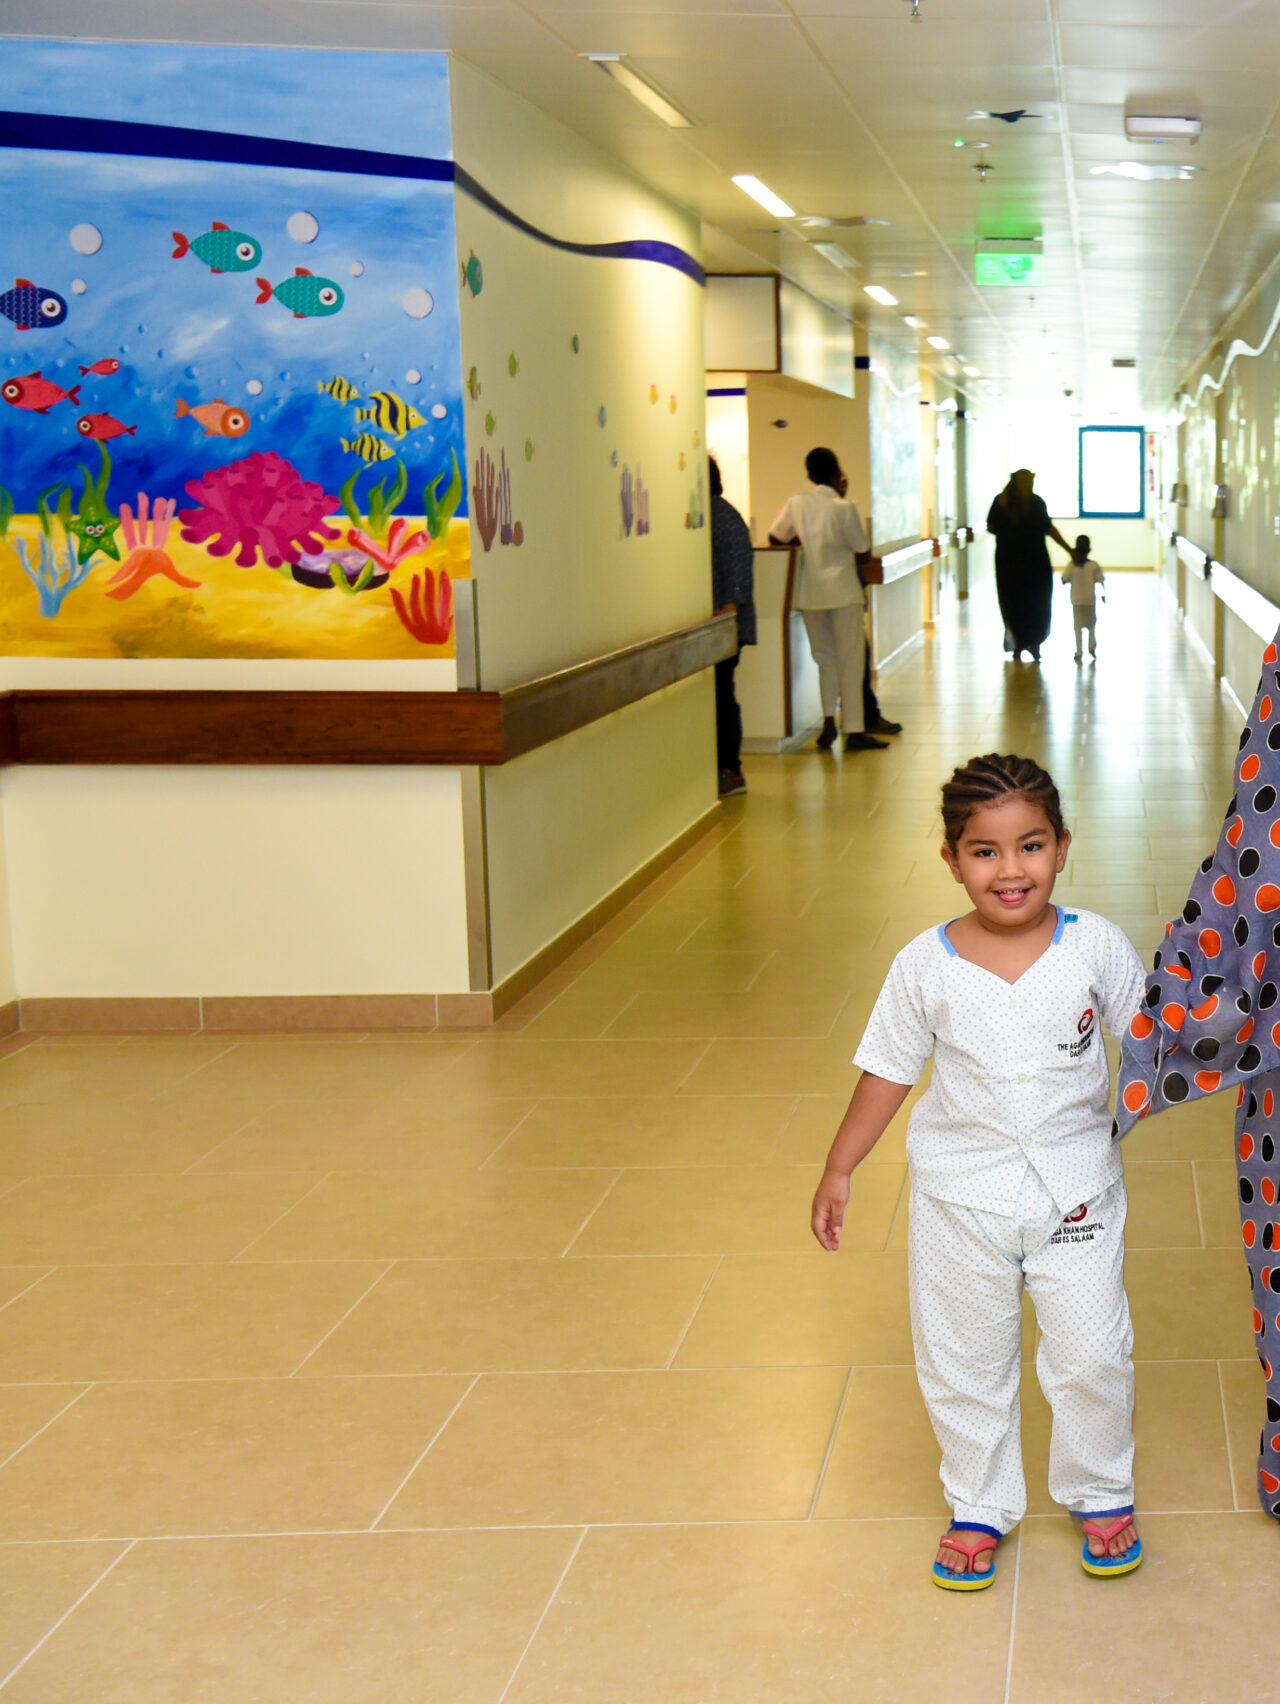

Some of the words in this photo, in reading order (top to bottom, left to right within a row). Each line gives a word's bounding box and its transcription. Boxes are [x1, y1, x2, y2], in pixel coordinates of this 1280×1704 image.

[1063, 1226, 1079, 1234] KHAN
[1080, 1222, 1105, 1232] HOSPITAL
[1051, 1236, 1062, 1244] DAR
[1071, 1233, 1094, 1242] SALAAM
